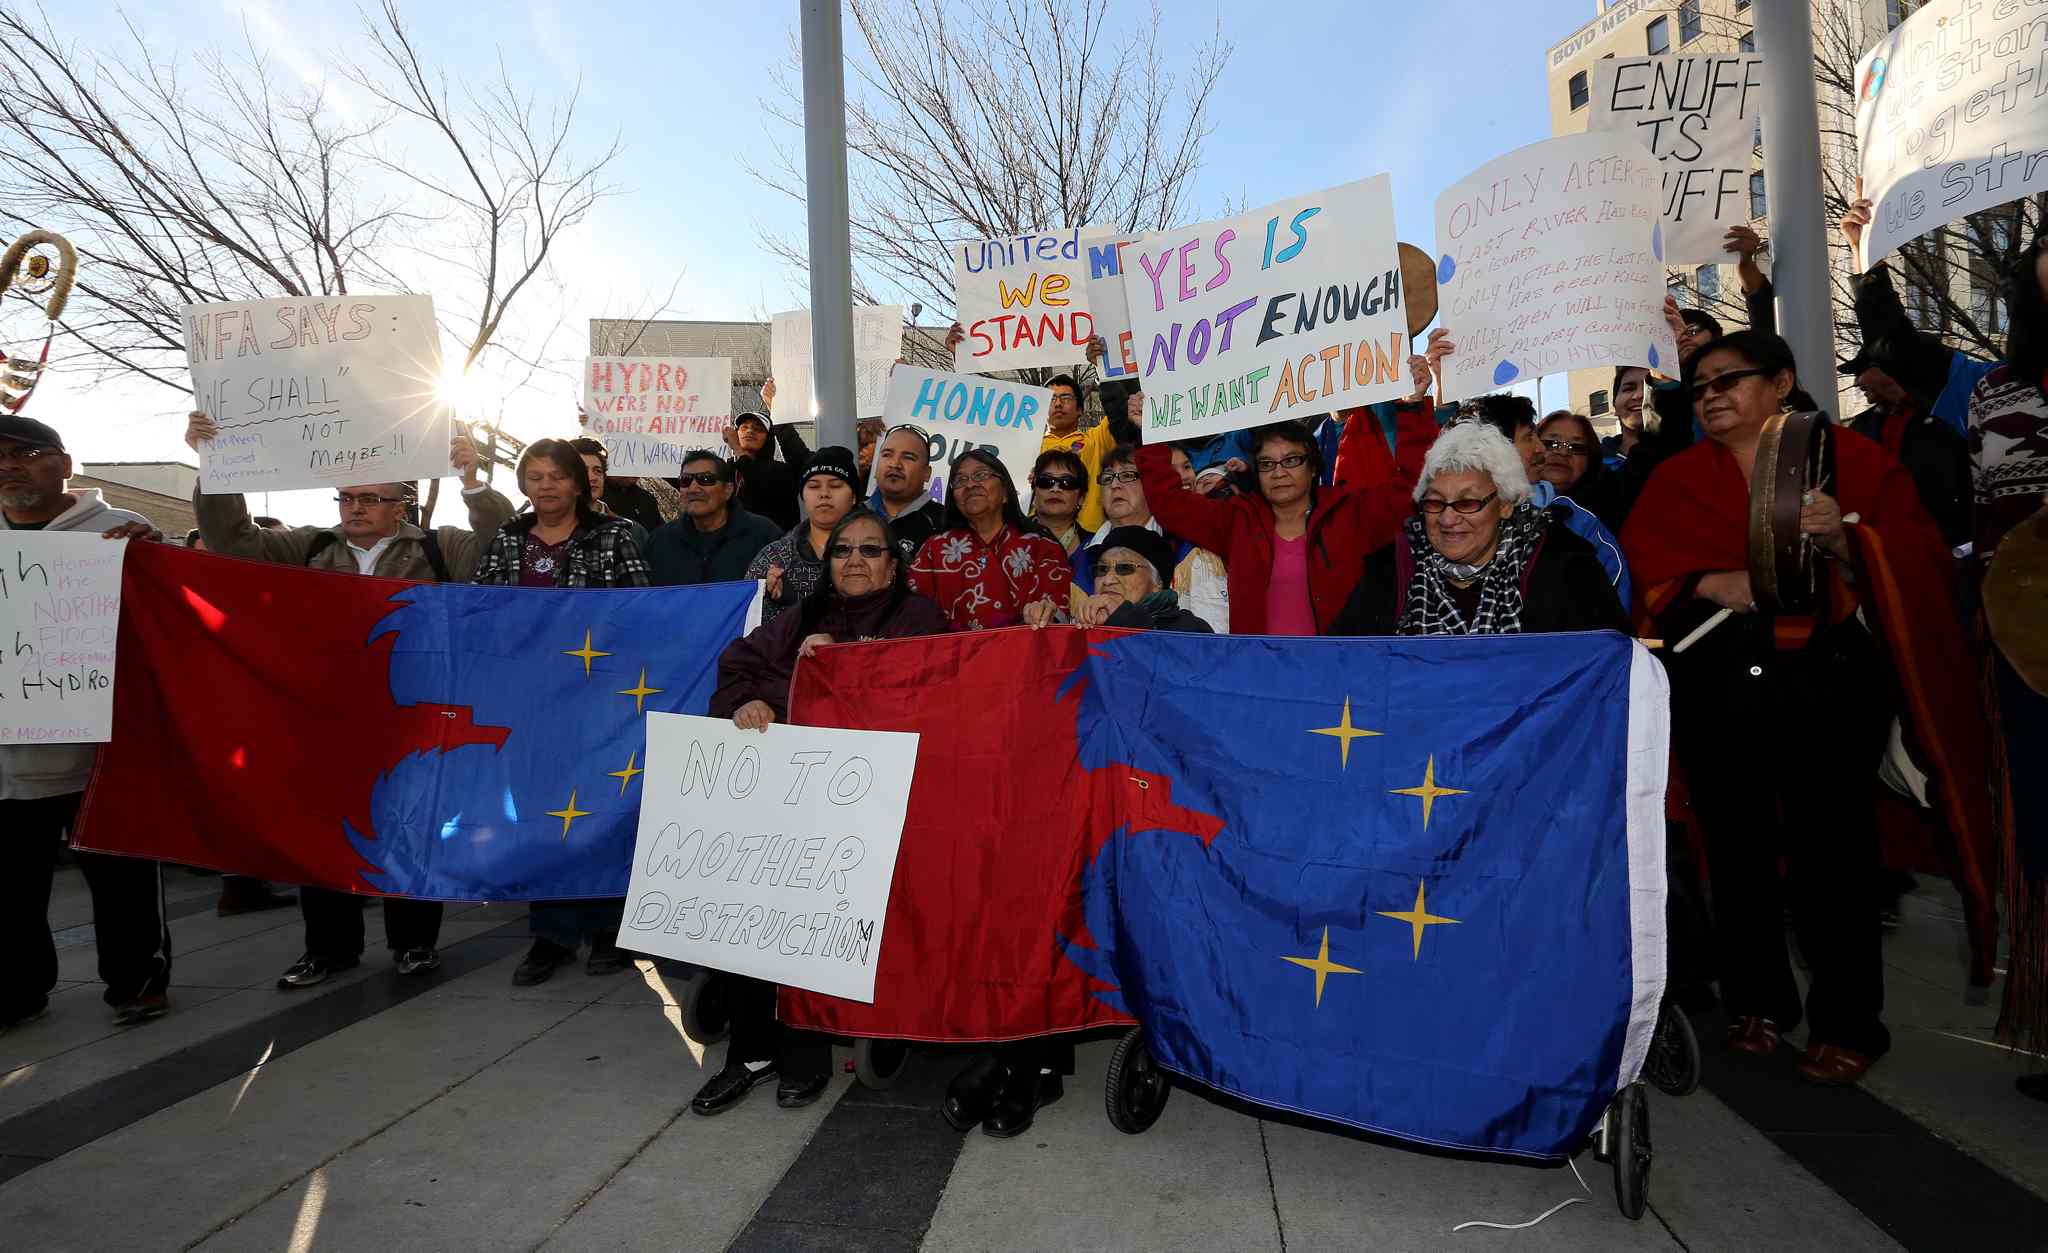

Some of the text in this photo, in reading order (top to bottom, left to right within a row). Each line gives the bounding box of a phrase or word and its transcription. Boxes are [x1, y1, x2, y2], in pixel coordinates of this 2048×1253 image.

[1611, 58, 1763, 120] ENUFF
[1637, 113, 1709, 162] IS
[1449, 168, 1545, 240] ONLY
[1521, 206, 1588, 240] RIVER
[1139, 207, 1322, 311] YES IS
[191, 310, 262, 363] NFA
[969, 311, 1094, 356] STAND
[1146, 268, 1399, 377] NOT ENOUGH
[592, 362, 688, 393] HYDRO
[594, 394, 699, 413] WERE NOT
[1150, 332, 1402, 428] WE WANT ACTION
[302, 420, 351, 441] NOT
[593, 415, 733, 434] GOING ANYWHERE
[911, 378, 1040, 431] HONOR
[680, 739, 873, 806] NO TO
[645, 822, 866, 894] MOTHER
[629, 890, 874, 966] DESTRUCTION
